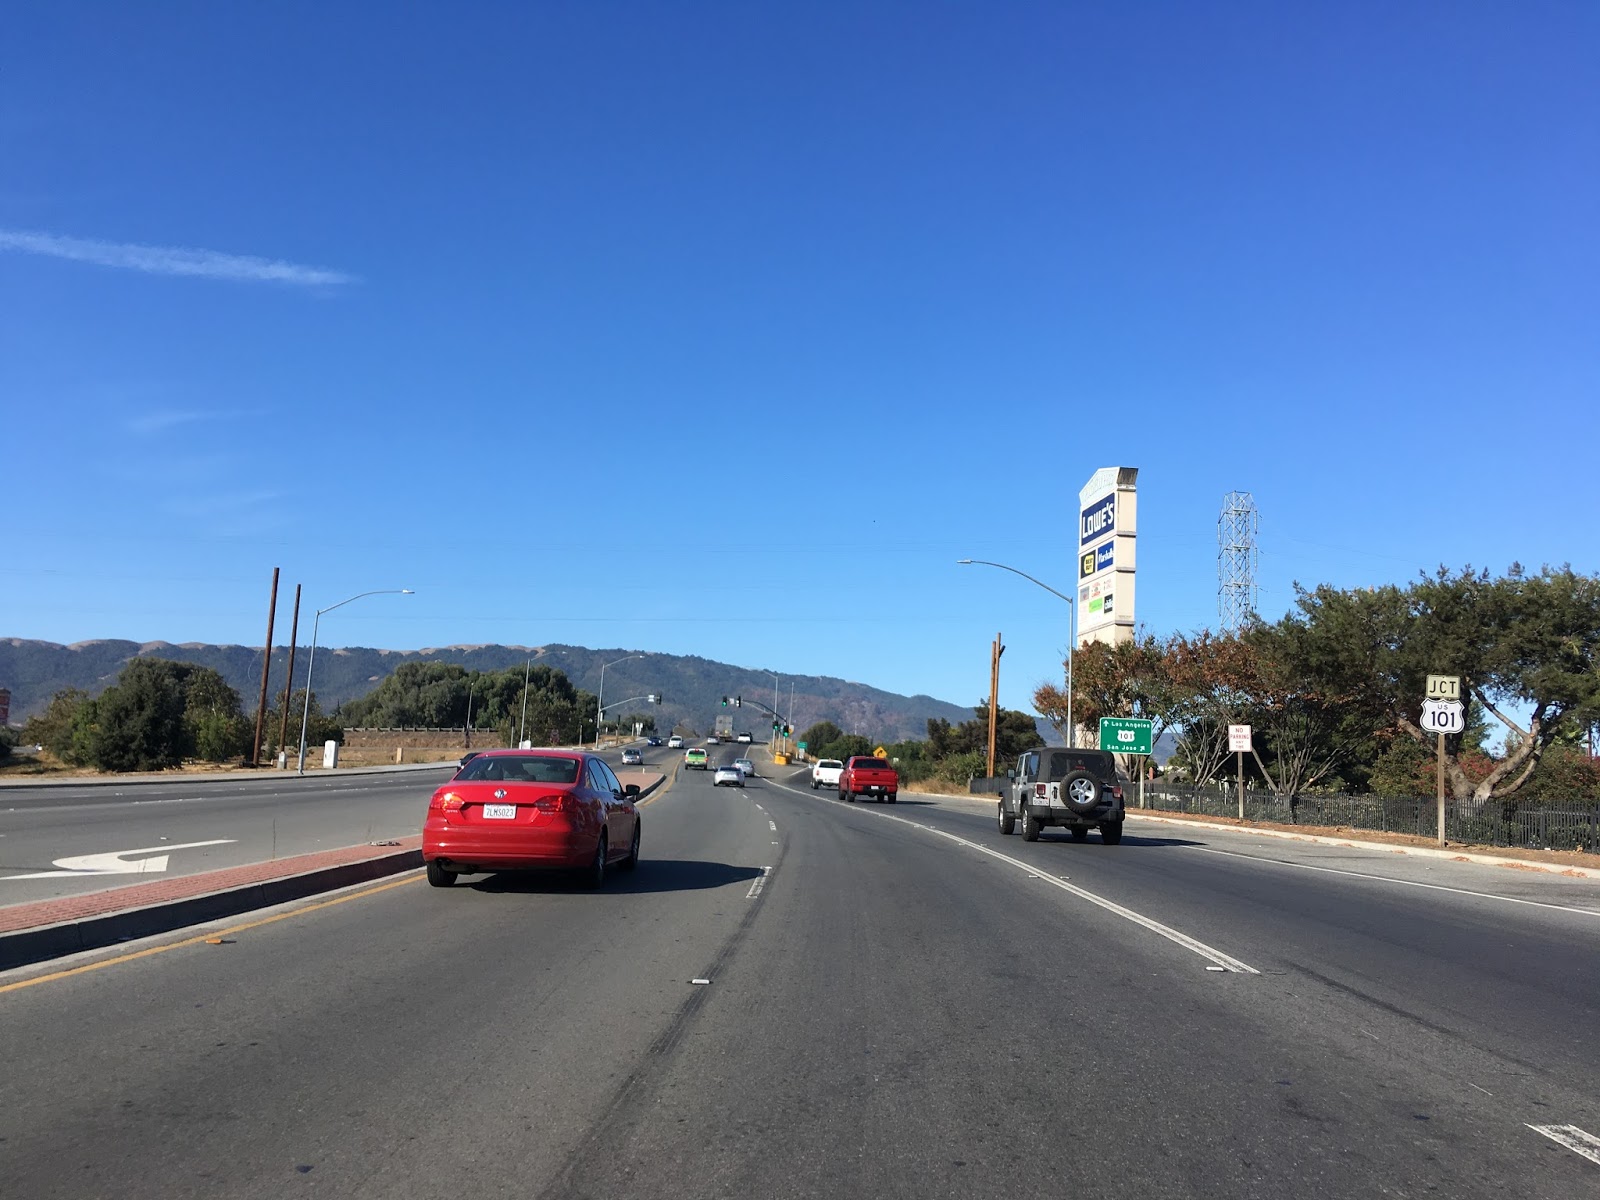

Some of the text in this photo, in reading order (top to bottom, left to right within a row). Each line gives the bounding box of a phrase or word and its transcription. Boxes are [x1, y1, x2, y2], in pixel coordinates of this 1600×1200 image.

[1082, 502, 1114, 539] LOWE'S
[1429, 680, 1456, 694] JCT
[1431, 711, 1455, 728] 101
